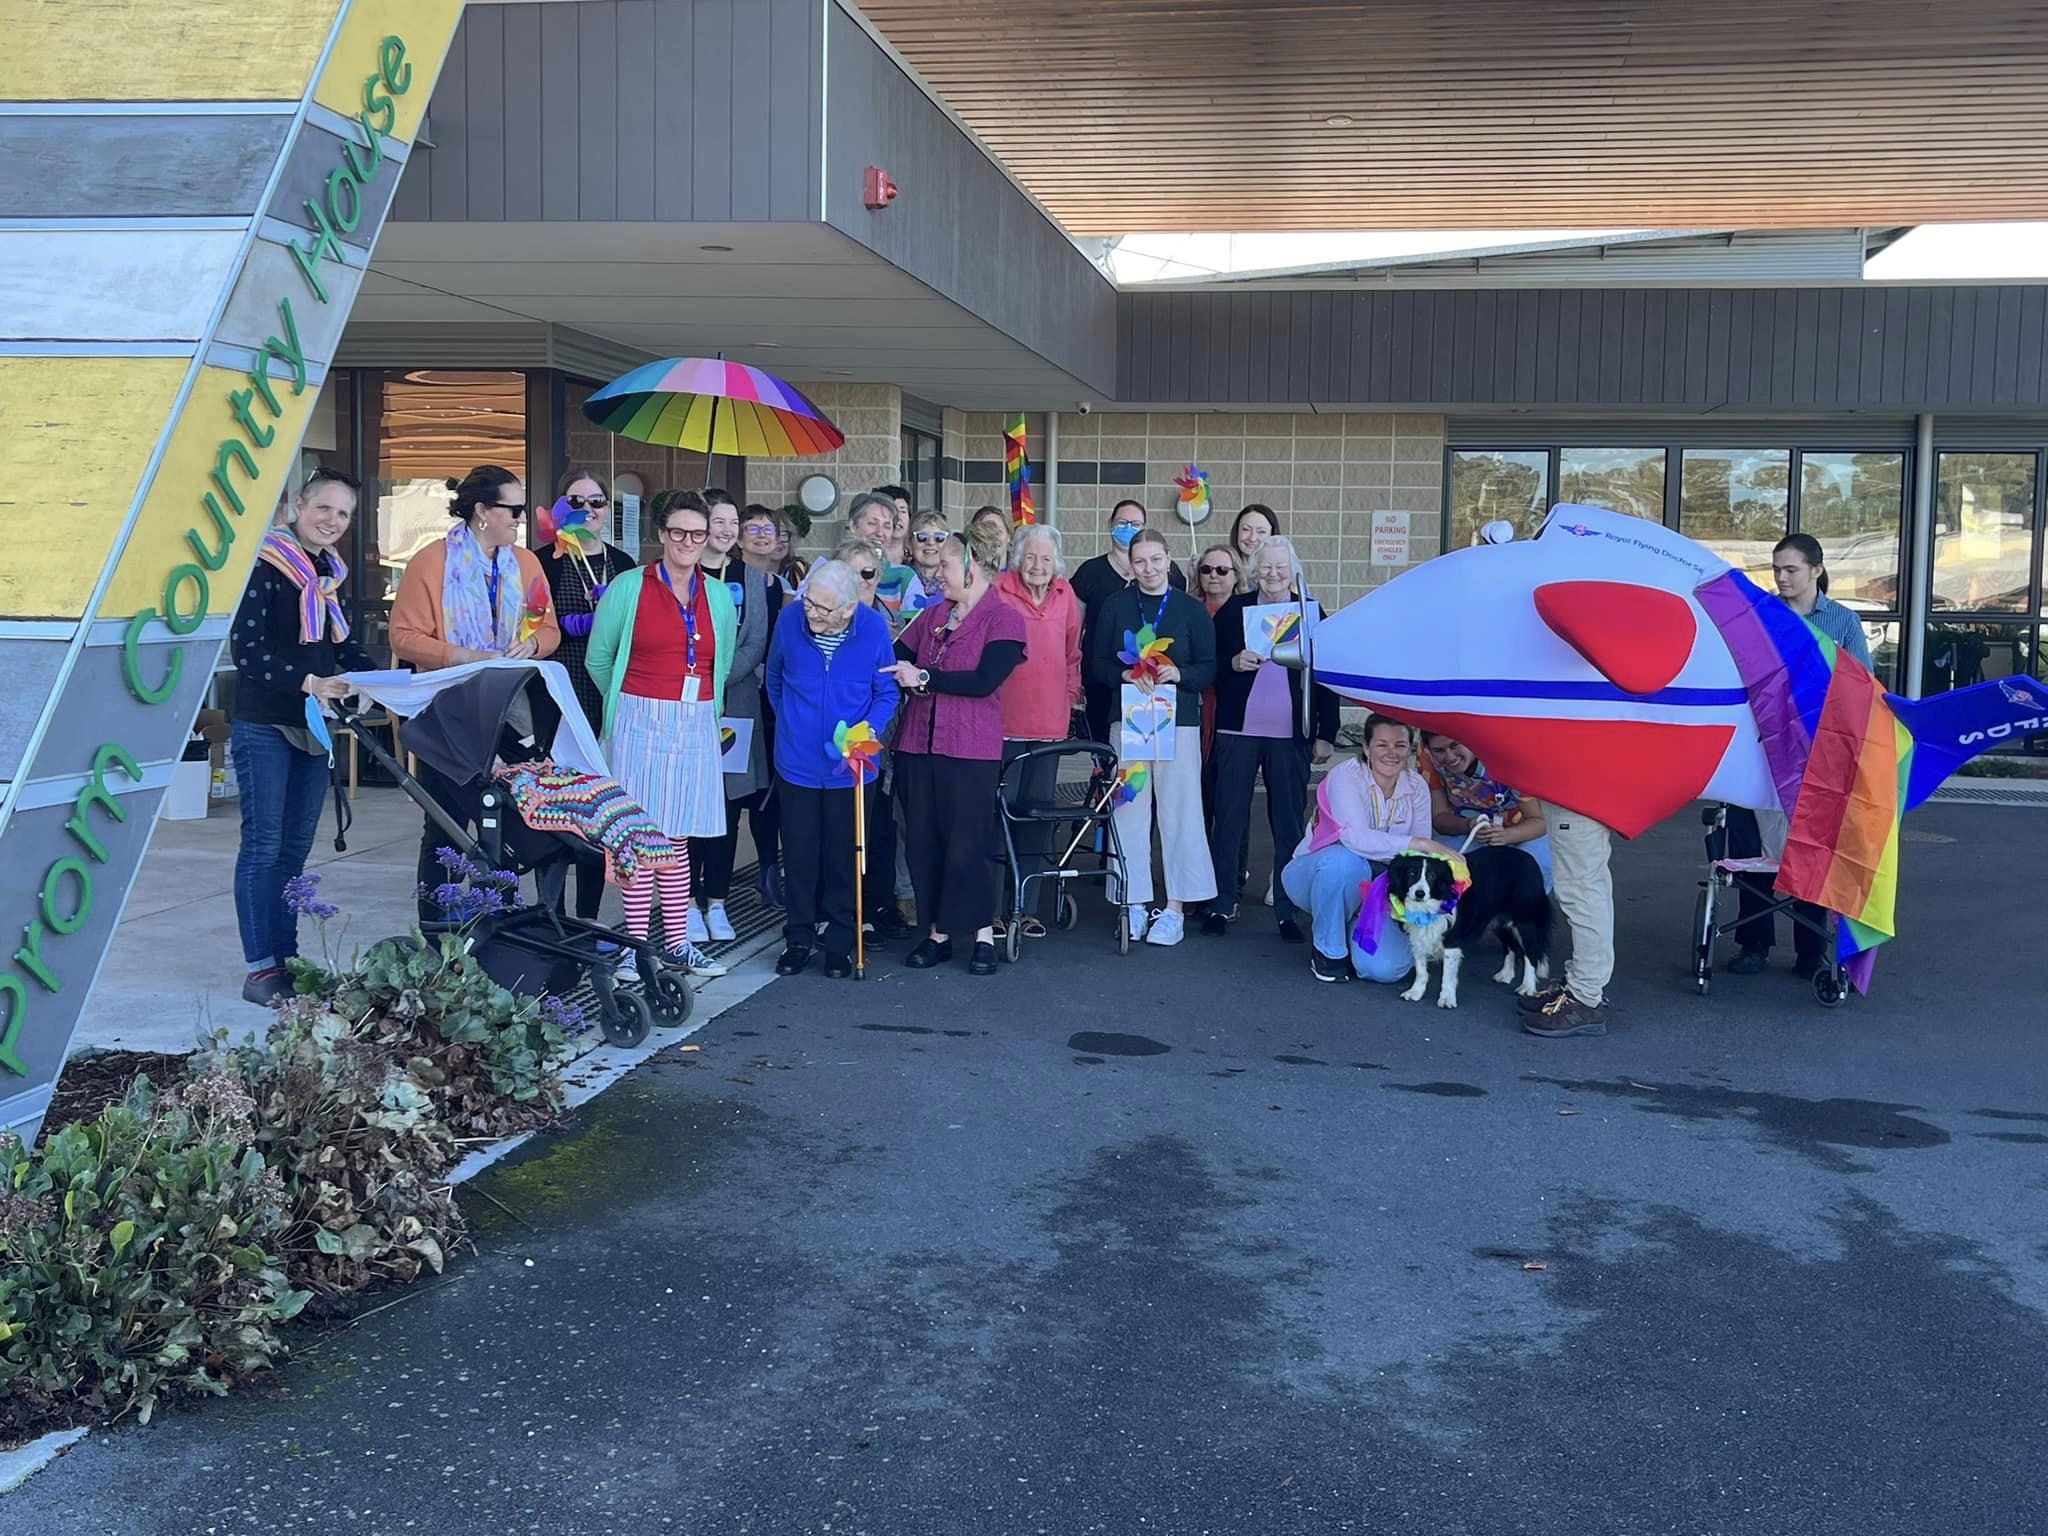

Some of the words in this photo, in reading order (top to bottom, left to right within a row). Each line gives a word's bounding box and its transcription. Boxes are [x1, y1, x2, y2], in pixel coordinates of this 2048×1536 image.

[1385, 515, 1396, 523] NO
[1375, 526, 1406, 534] PARKING
[0, 742, 144, 1078] Prom
[124, 297, 306, 705] Country
[288, 35, 412, 305] House
[1604, 532, 1632, 545] Royal
[1633, 539, 1661, 554] Flying
[1661, 549, 1692, 567] Doctor
